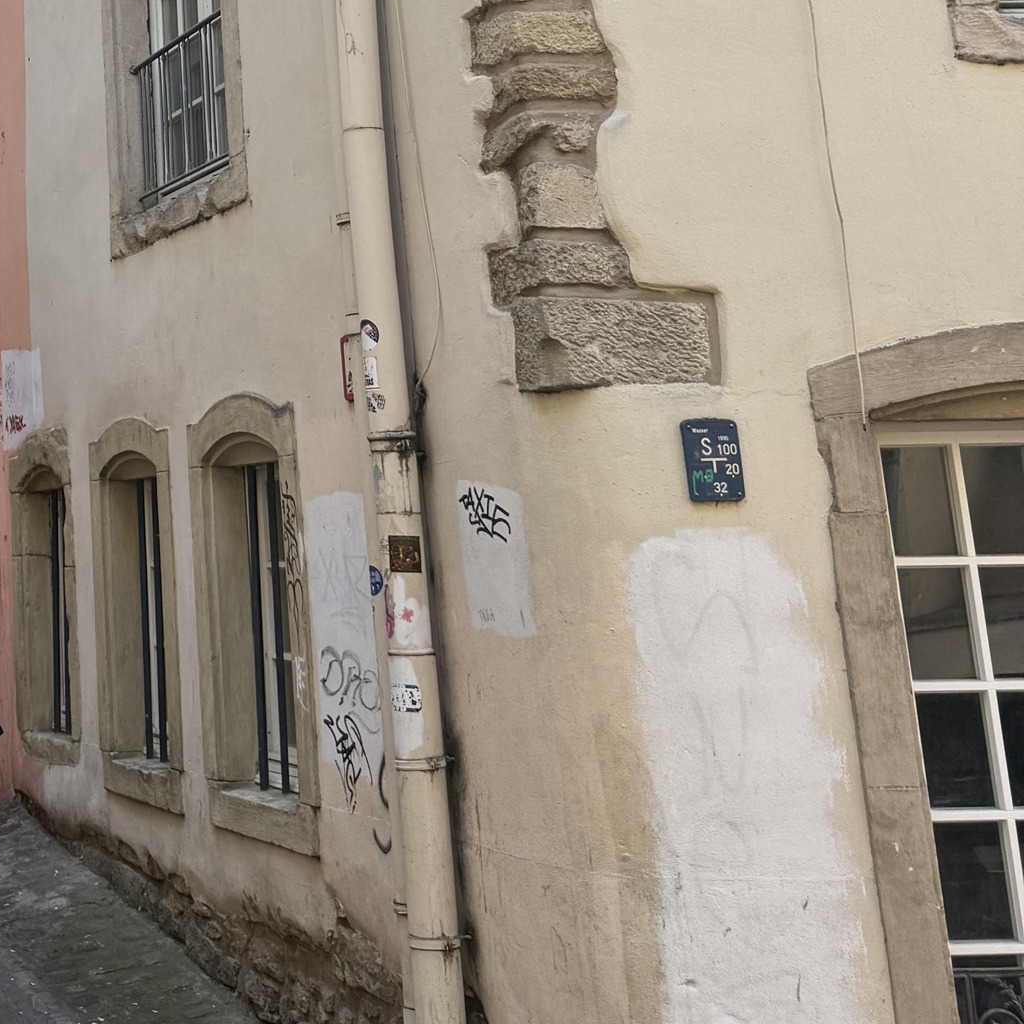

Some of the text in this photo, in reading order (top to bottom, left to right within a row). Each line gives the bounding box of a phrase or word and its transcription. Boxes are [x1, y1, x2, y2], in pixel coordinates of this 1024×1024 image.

[700, 437, 737, 456] S 100
[725, 463, 740, 475] 20
[713, 481, 728, 493] 32
